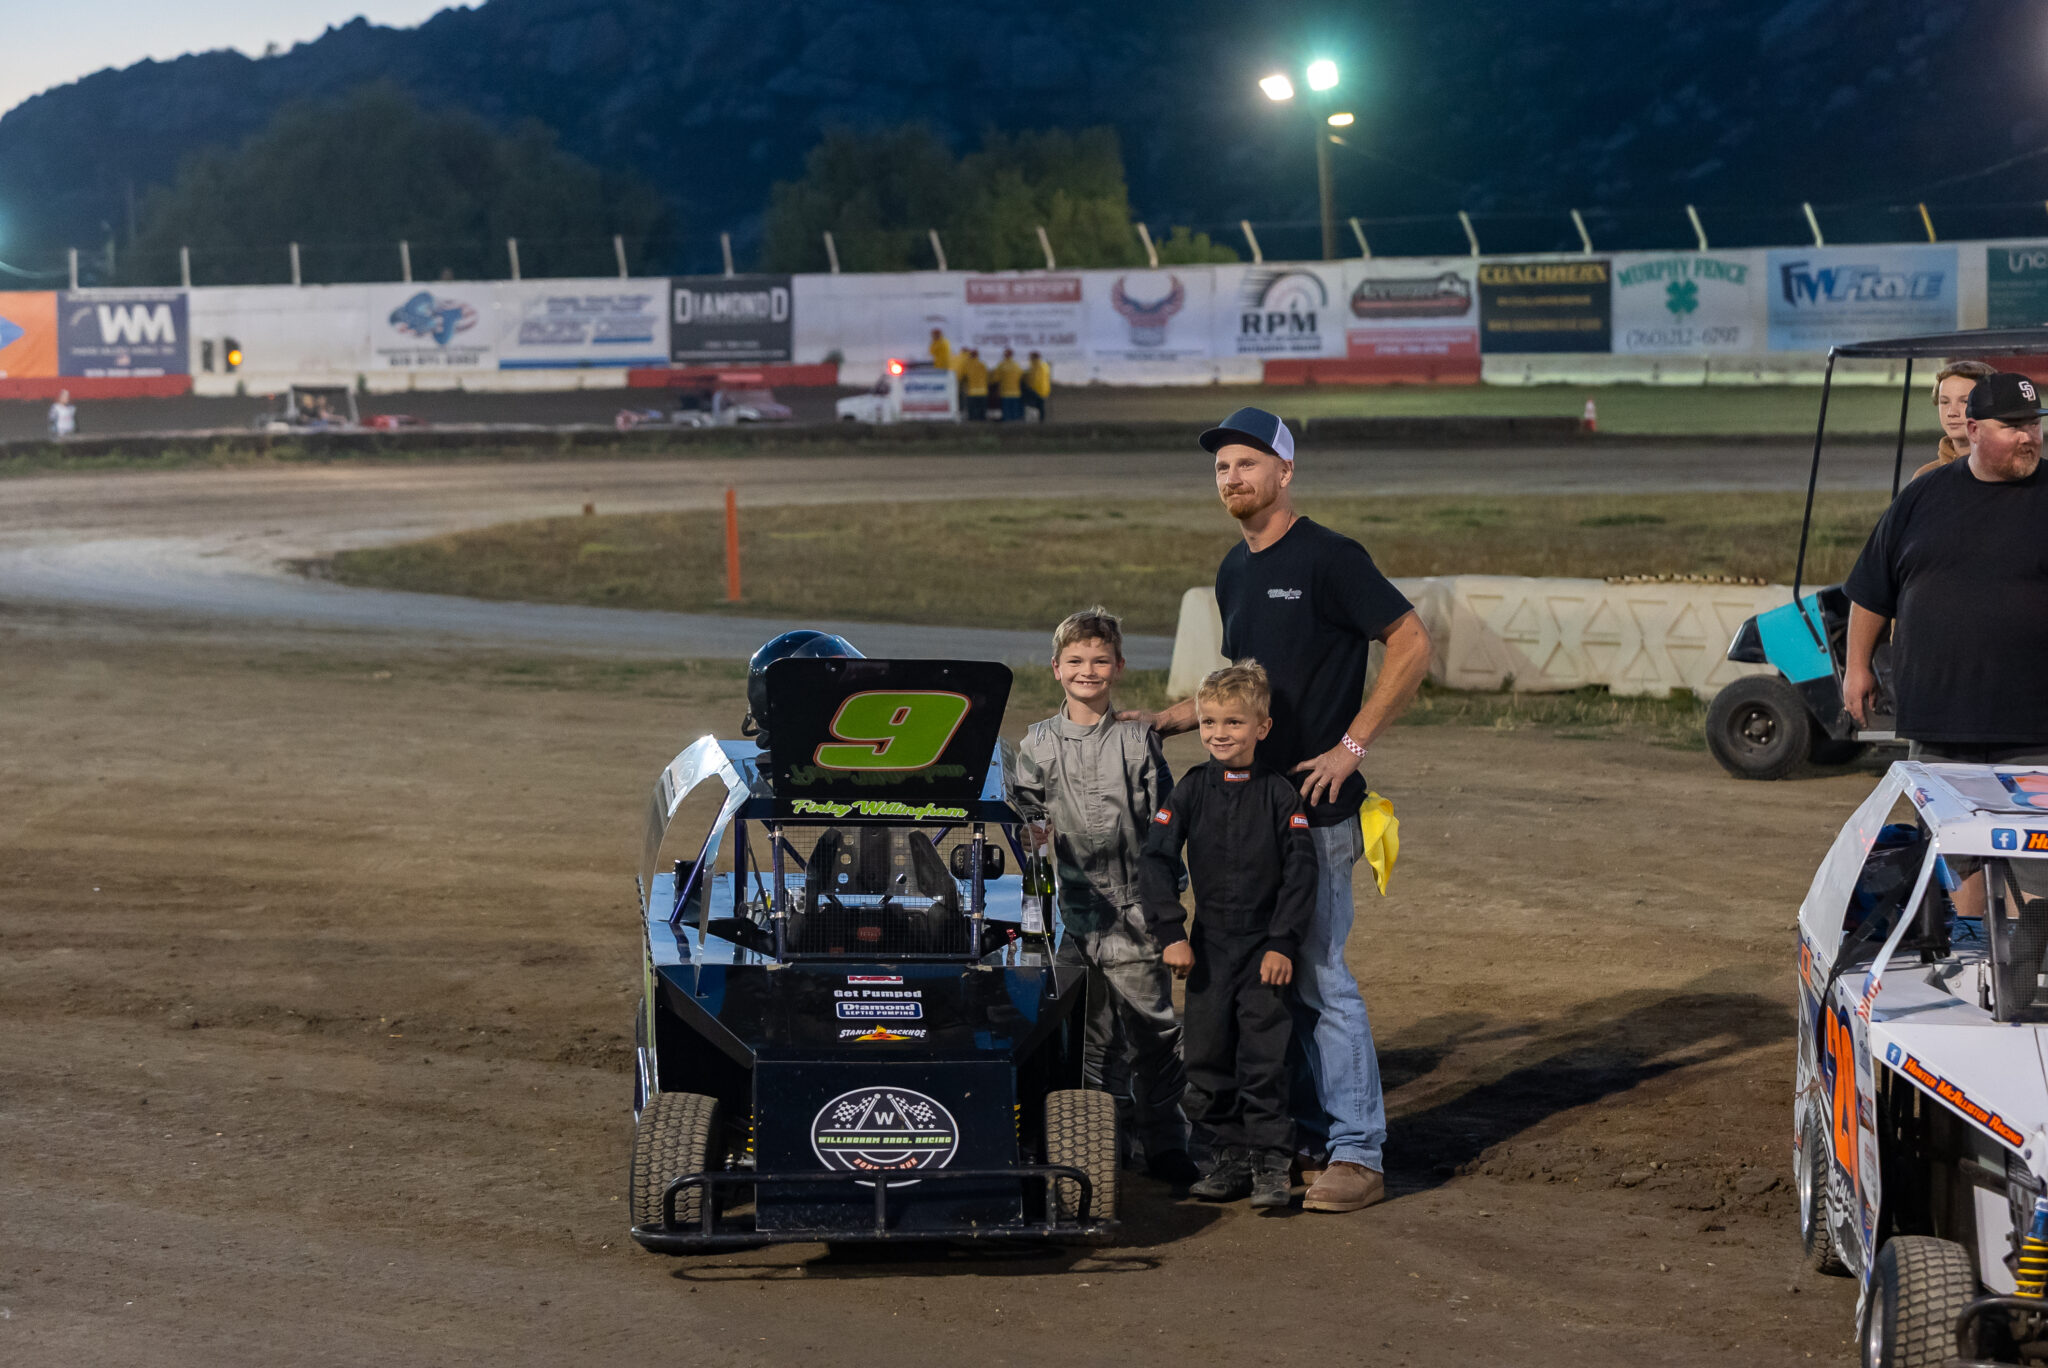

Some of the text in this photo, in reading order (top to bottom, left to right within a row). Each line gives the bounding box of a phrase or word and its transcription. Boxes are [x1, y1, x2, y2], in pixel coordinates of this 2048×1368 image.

[1617, 257, 1690, 288] MURPHY
[1695, 257, 1748, 286] FENCE
[97, 303, 177, 345] WM
[1242, 311, 1317, 334] RPM
[812, 689, 972, 771] 9
[791, 799, 968, 821] Finley Willingham
[833, 989, 922, 999] Get Pumped
[842, 1003, 916, 1011] Diamond
[839, 1028, 927, 1039] STANLEY BACKHOE
[874, 1111, 895, 1126] W
[818, 1136, 952, 1144] WILLINGHAM BROS. RACING
